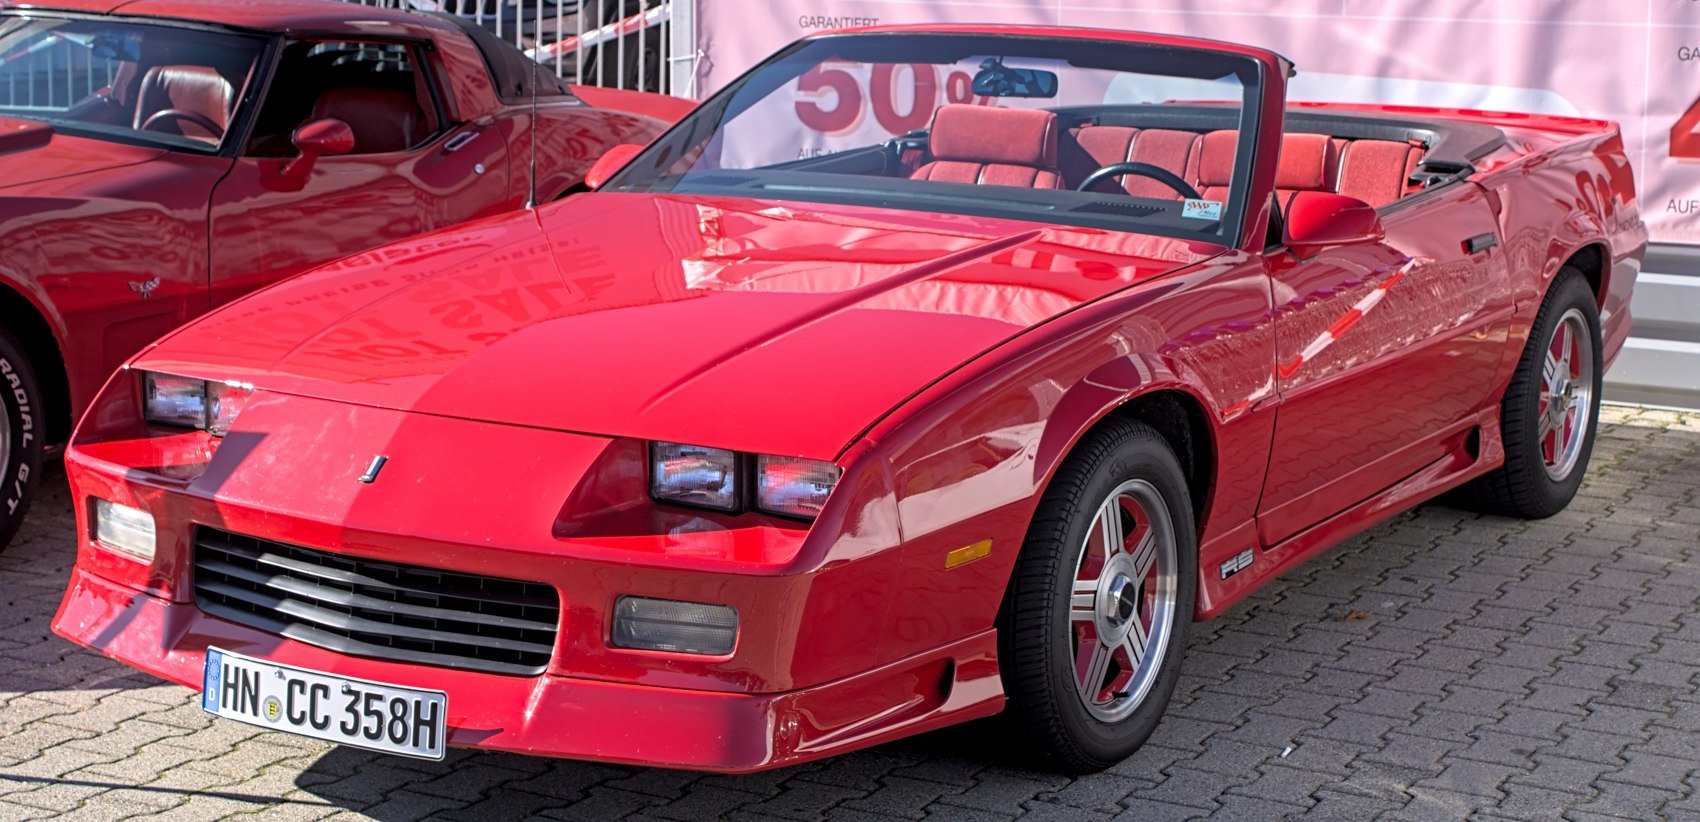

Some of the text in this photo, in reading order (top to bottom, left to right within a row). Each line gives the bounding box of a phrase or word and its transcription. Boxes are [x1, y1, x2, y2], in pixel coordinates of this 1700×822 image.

[1666, 199, 1699, 214] AUF
[0, 358, 33, 448] RADIAL
[1221, 548, 1253, 579] RS
[221, 663, 438, 749] HN CC 358H
